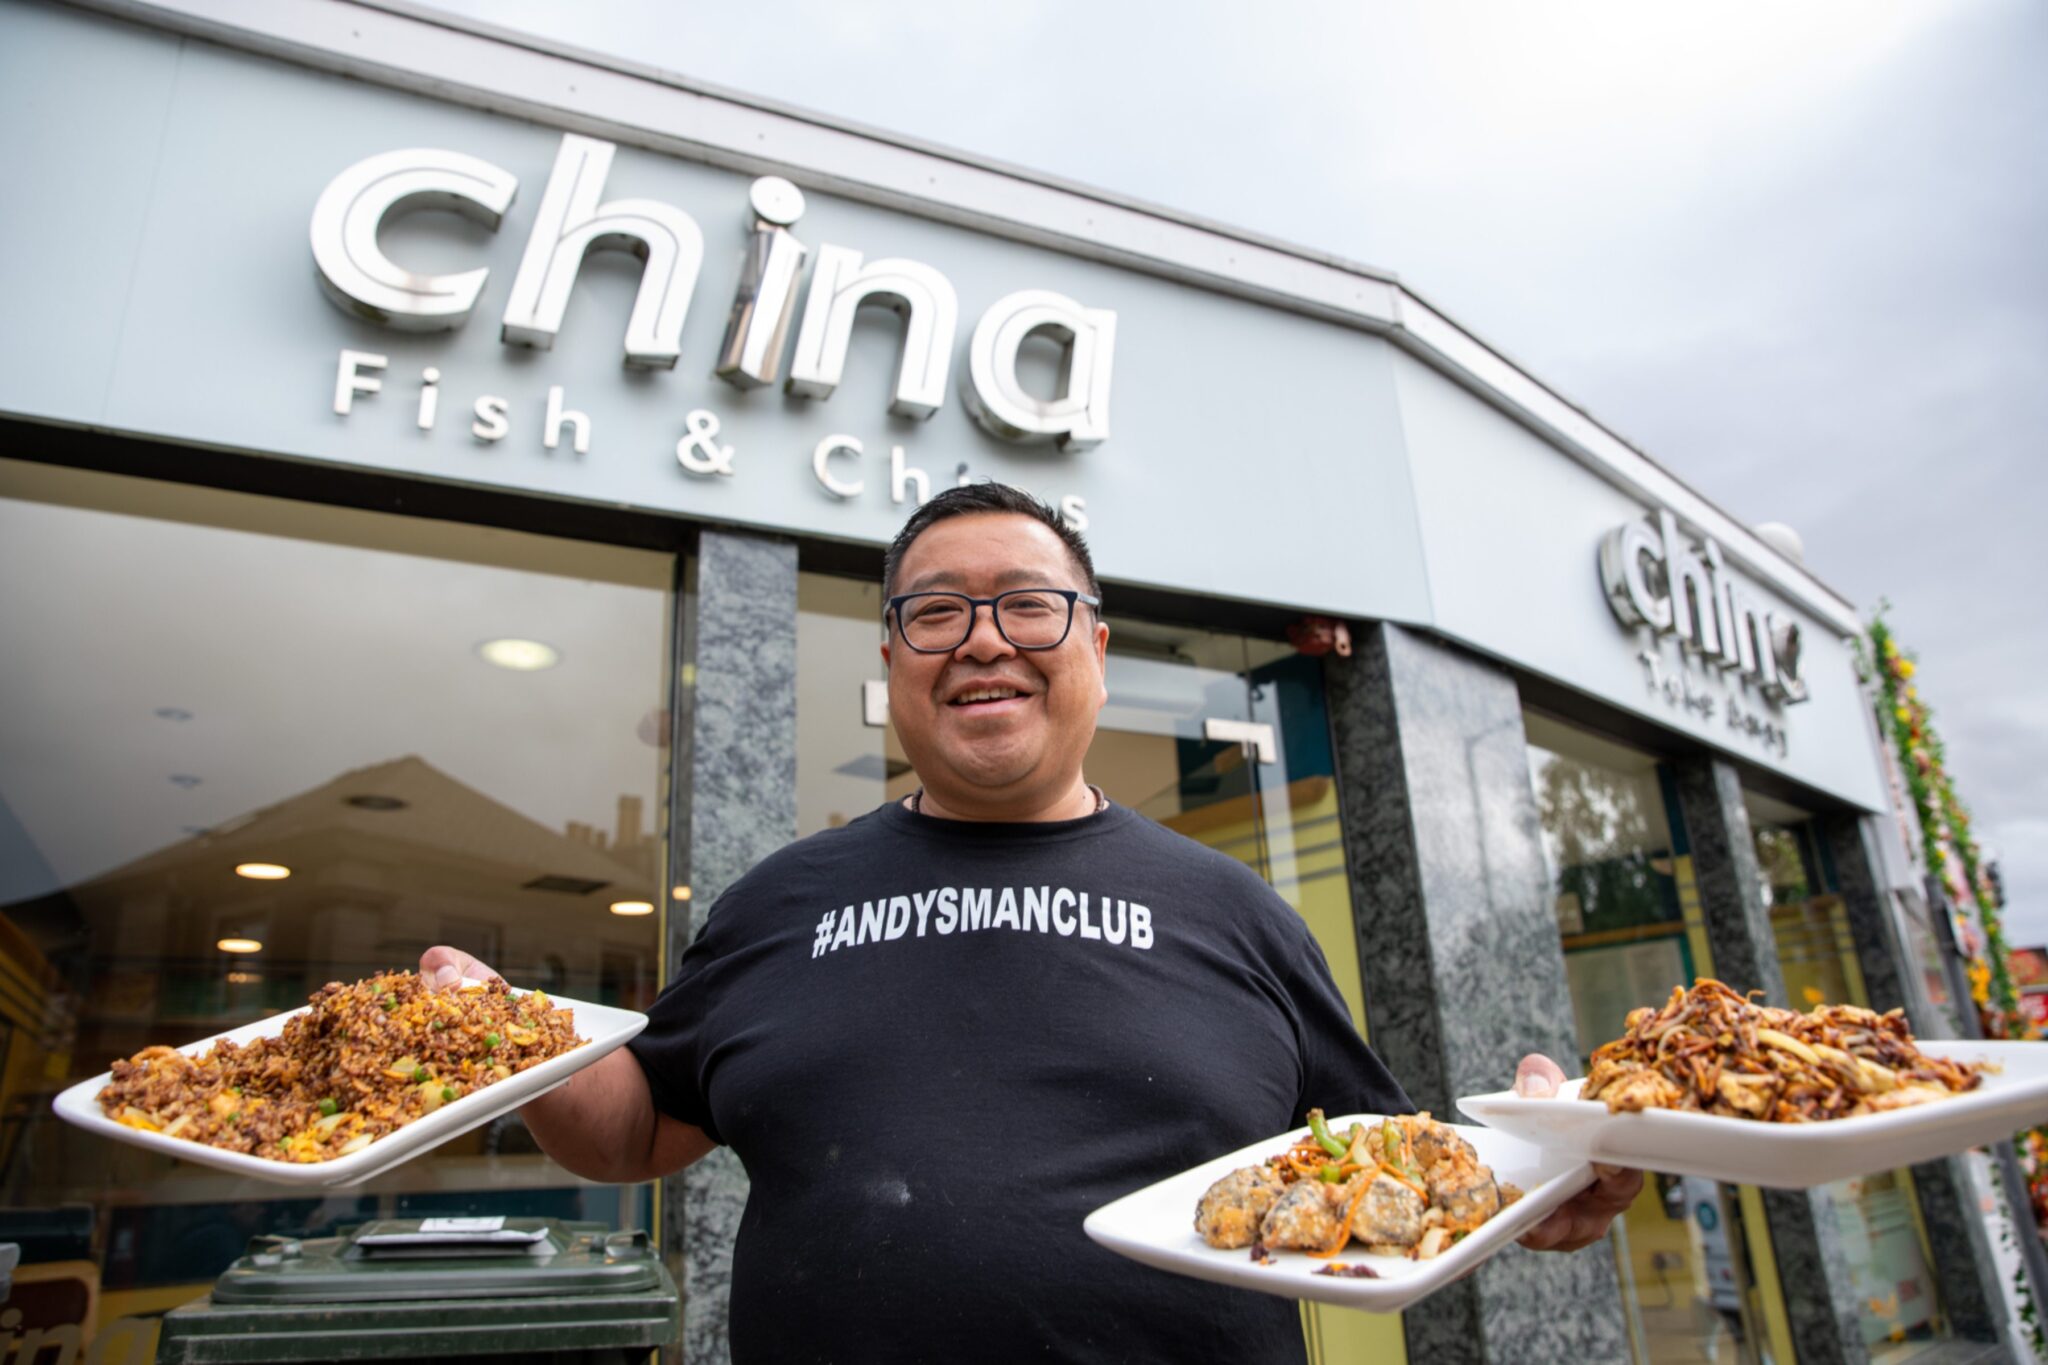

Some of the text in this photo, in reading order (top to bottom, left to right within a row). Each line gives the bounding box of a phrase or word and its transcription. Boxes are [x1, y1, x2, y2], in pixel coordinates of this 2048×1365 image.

[310, 132, 1118, 451] china
[333, 349, 1090, 531] Fish & Chs
[811, 885, 1155, 960] #ANDYSMANCLUB
